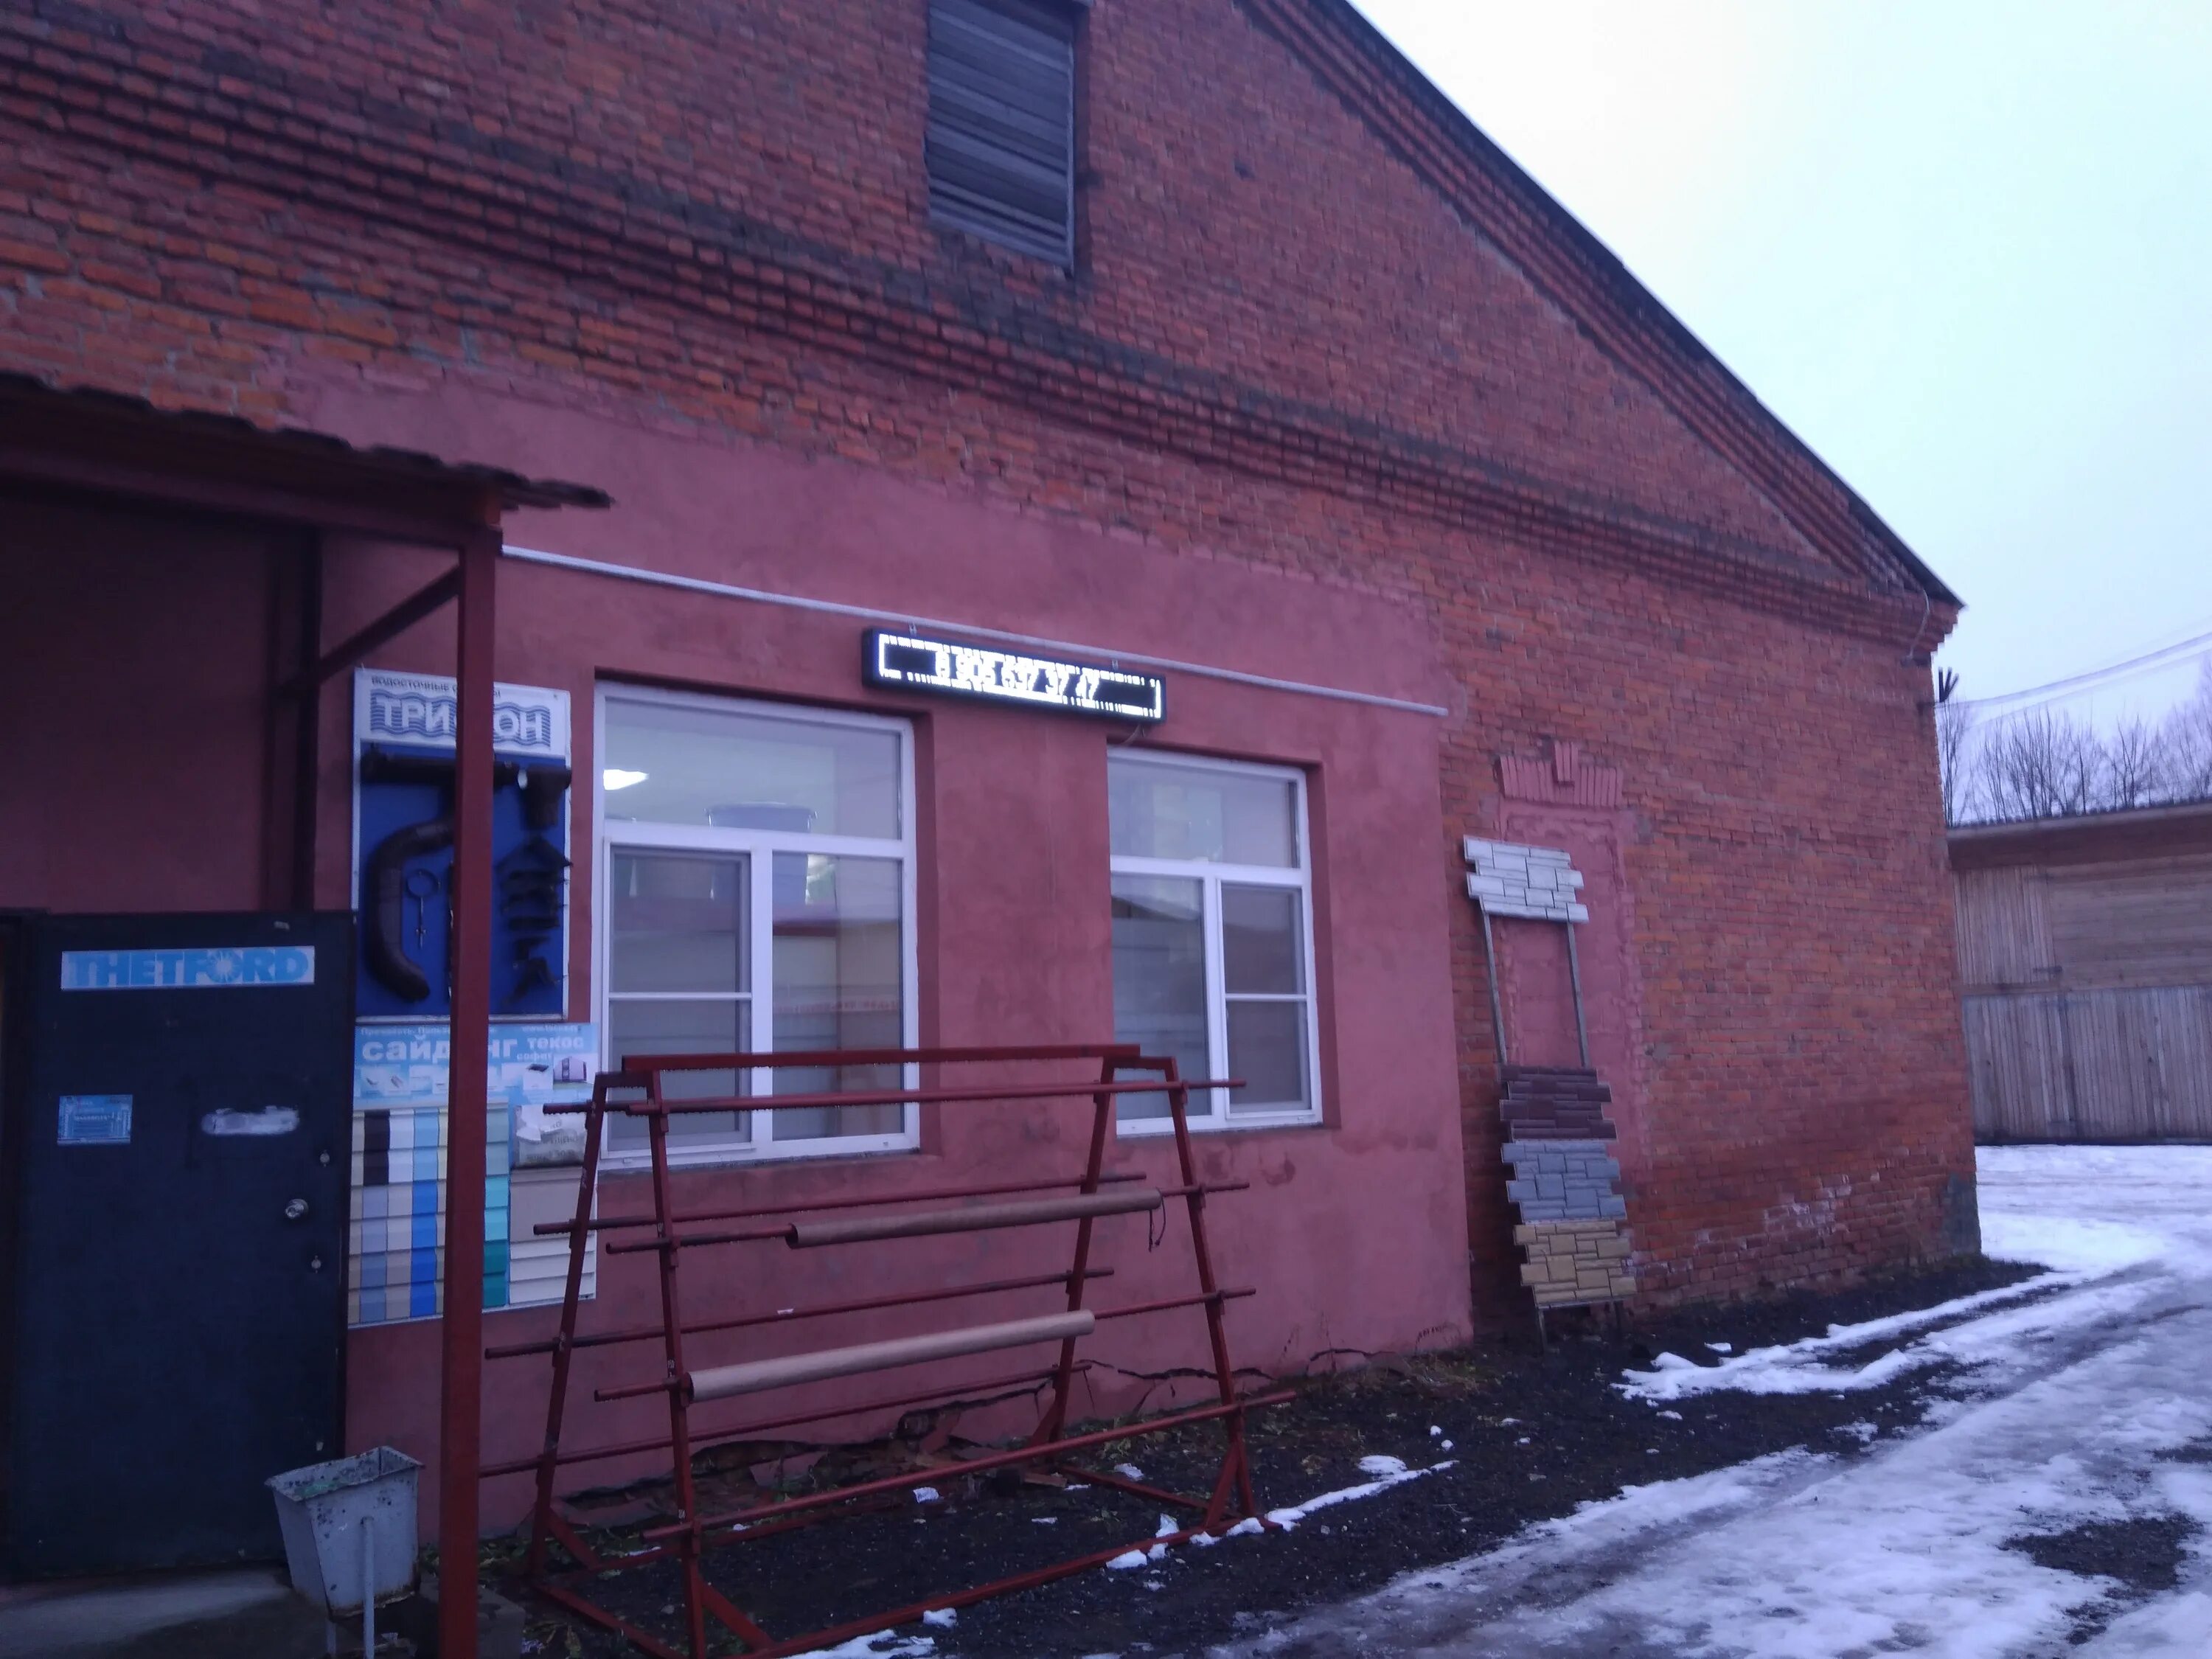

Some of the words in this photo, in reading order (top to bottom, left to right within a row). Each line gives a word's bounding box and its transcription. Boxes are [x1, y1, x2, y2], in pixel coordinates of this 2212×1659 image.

[375, 695, 543, 740] ТРИОН
[71, 949, 308, 987] THETFORD
[362, 1034, 518, 1064] сайднг
